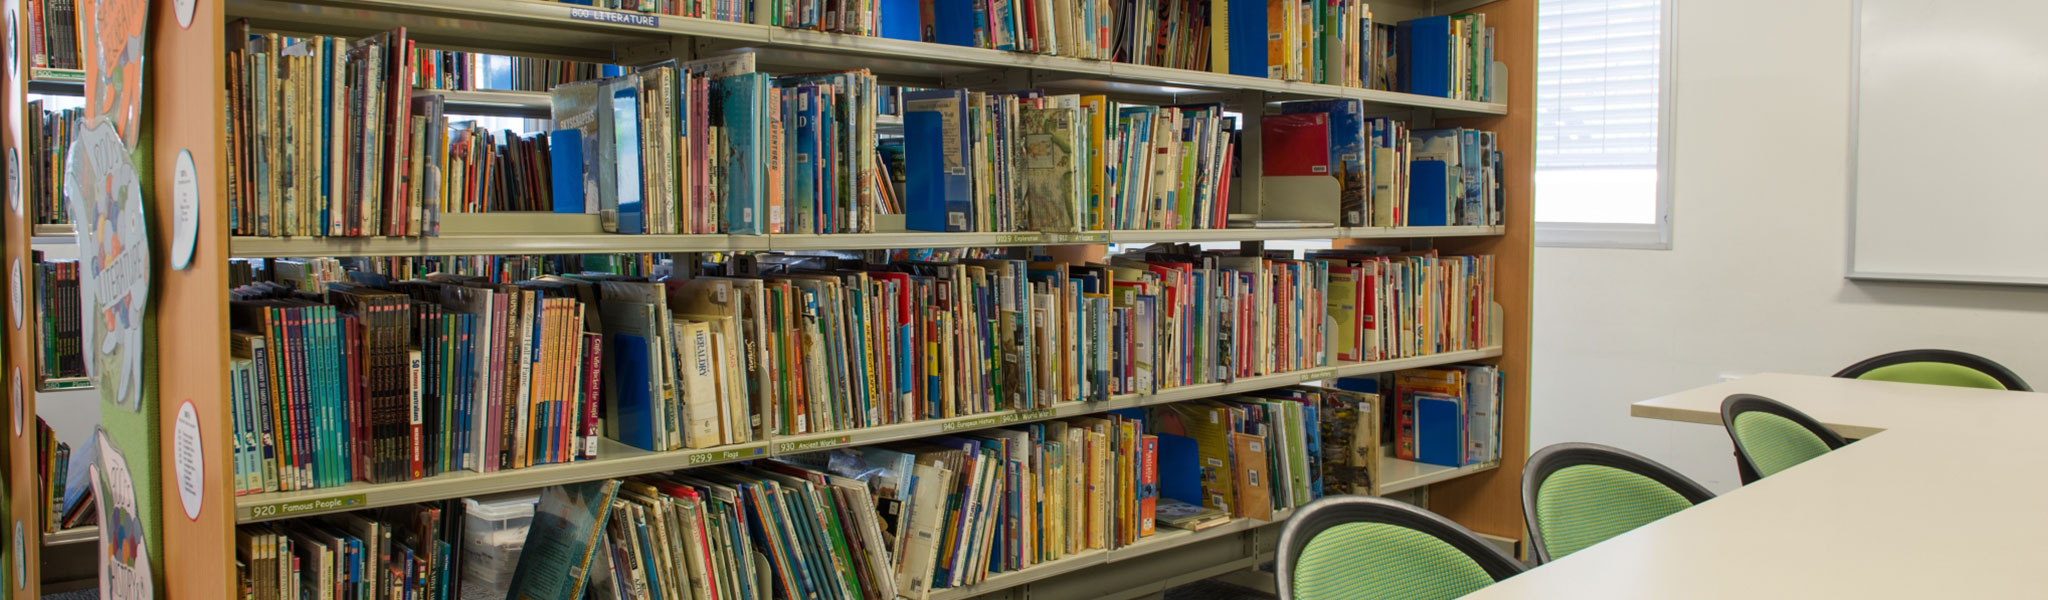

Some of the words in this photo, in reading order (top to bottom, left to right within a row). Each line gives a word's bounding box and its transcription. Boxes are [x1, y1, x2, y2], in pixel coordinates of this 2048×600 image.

[572, 8, 589, 18] 800
[594, 10, 655, 26] LITERATURE
[771, 117, 780, 171] ADVENTURES
[525, 313, 533, 338] Zealand
[523, 339, 531, 355] Hall
[695, 329, 707, 376] HERALDRY
[412, 360, 420, 368] 50
[521, 367, 530, 387] Fame
[257, 358, 265, 381] DICTIONARY
[261, 405, 270, 432] AUSTRALIANS
[413, 391, 421, 422] australians
[1022, 411, 1038, 420] World
[943, 422, 955, 431] 940
[956, 420, 978, 429] European
[978, 418, 996, 427] History
[780, 442, 795, 452] 930
[798, 440, 819, 449] Ancient
[820, 438, 837, 447] World
[690, 453, 713, 464] 929.9
[723, 451, 739, 460] Flags
[253, 504, 276, 518] 920
[282, 502, 314, 513] Famous
[315, 498, 342, 508] People
